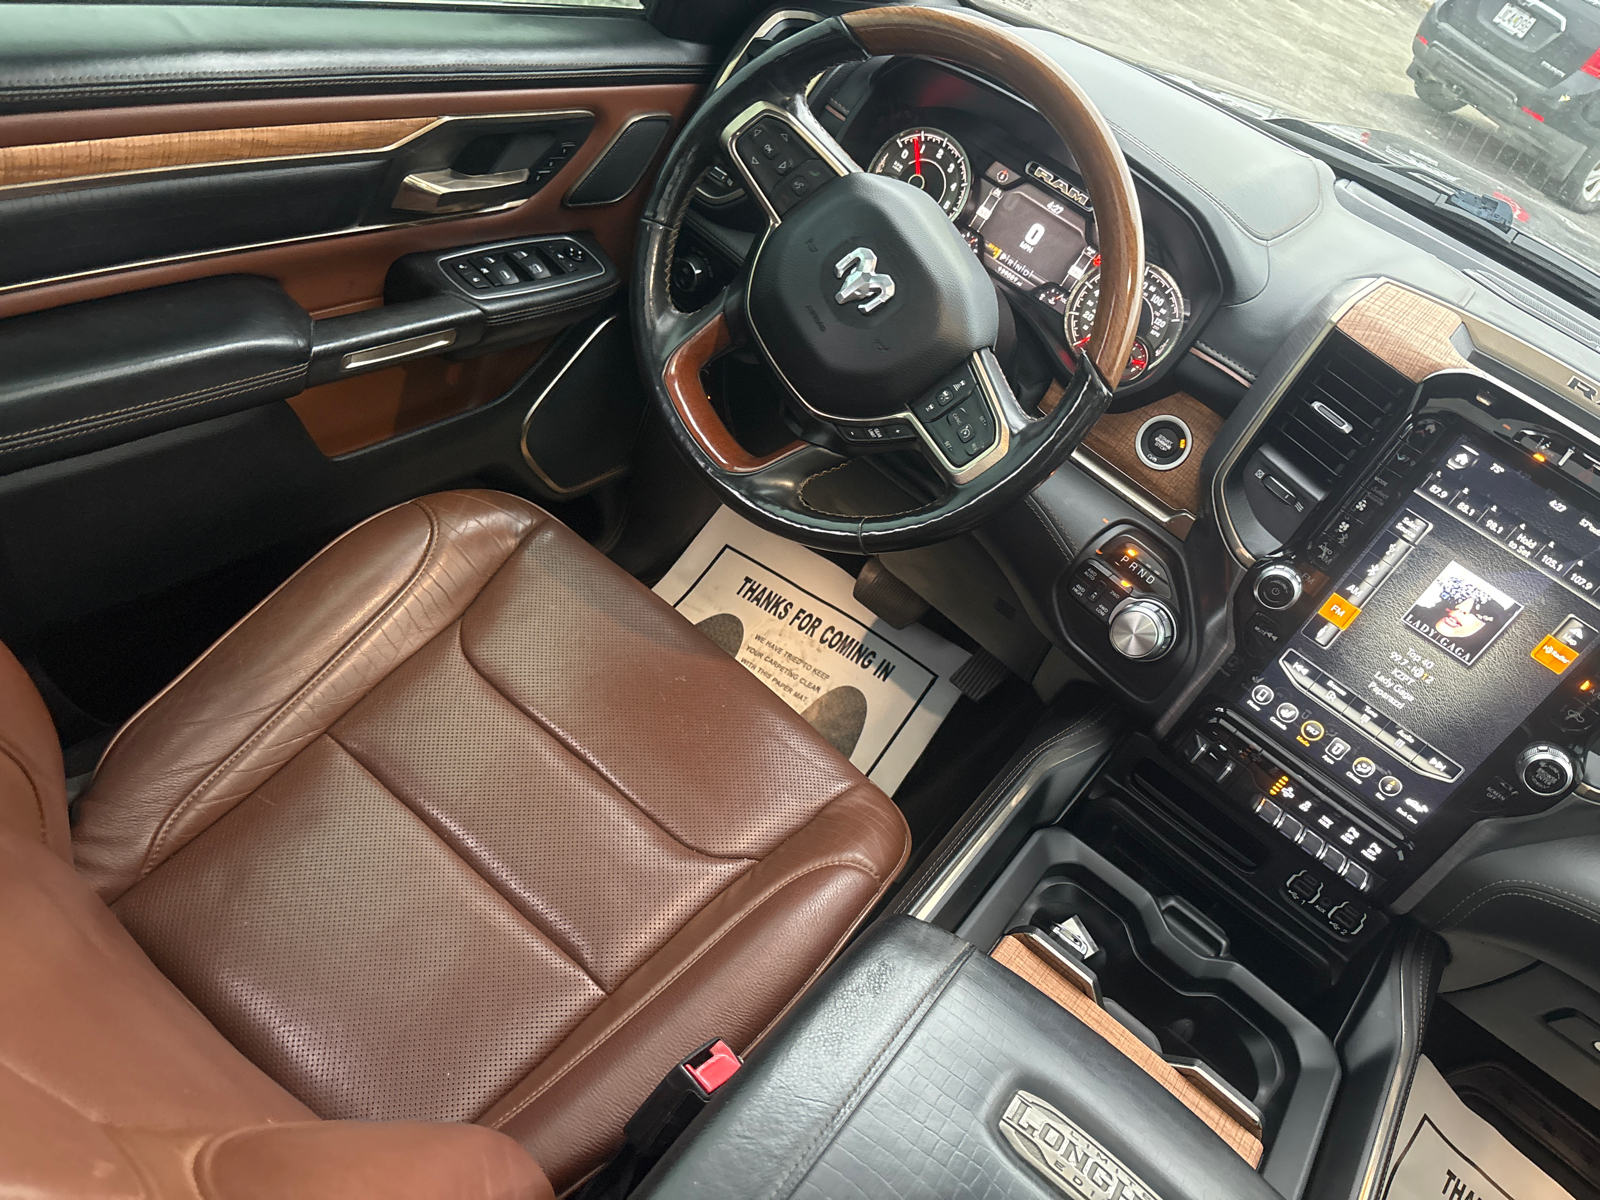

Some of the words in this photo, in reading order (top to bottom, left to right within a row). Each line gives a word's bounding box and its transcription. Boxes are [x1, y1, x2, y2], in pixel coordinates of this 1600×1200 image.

[764, 144, 773, 153] OK
[901, 149, 909, 159] 0
[919, 144, 926, 154] 1
[935, 148, 944, 159] 2
[947, 163, 955, 173] 3
[950, 182, 957, 191] 4
[1034, 166, 1089, 206] RAM
[1047, 201, 1064, 215] 4:27
[1025, 223, 1045, 246] 0
[1019, 241, 1034, 253] MPH
[1151, 294, 1164, 306] 100
[1083, 311, 1094, 321] 20
[1154, 319, 1166, 328] 120
[873, 428, 883, 438] GEAR
[1158, 434, 1173, 444] START
[1429, 485, 1448, 498] 87.9
[1457, 501, 1476, 517] 88.1
[1549, 500, 1567, 513] 4:27
[1395, 522, 1416, 538] Source
[1402, 516, 1420, 532] Select
[1486, 519, 1504, 535] 98.1
[1516, 533, 1537, 549] Hold
[1508, 540, 1518, 550] to
[1517, 546, 1532, 559] Set
[1541, 554, 1563, 572] 105.1
[1570, 573, 1593, 591] 107.9
[1346, 584, 1364, 598] AM
[1330, 604, 1345, 617] FM
[736, 576, 793, 620] THANKS
[789, 608, 822, 638] FOR
[819, 625, 877, 669] COMING
[873, 659, 896, 682] IN
[1405, 614, 1437, 637] LADY
[1440, 637, 1471, 662] GAGA
[1562, 631, 1577, 646] Map
[754, 633, 765, 644] WE
[765, 640, 784, 654] HAVE
[784, 650, 802, 665] TRIED
[801, 660, 812, 670] TO
[812, 666, 830, 681] KEEP
[1389, 651, 1409, 666] 99.7
[1407, 647, 1420, 662] Top
[1422, 658, 1435, 669] 40
[741, 657, 757, 670] WITH
[757, 667, 772, 679] THIS
[772, 677, 793, 694] PAPER
[746, 645, 764, 659] YOUR
[764, 655, 799, 680] CARPETING
[800, 677, 821, 693] CLEAN
[1391, 667, 1415, 686] KZPT
[1374, 671, 1394, 688] Lady
[1394, 685, 1415, 702] Gaga
[1368, 681, 1405, 709] Paparazzi
[1364, 705, 1378, 718] Tune
[1397, 730, 1415, 744] Audio
[1487, 786, 1505, 801] SCREEN
[1314, 905, 1326, 913] AUX
